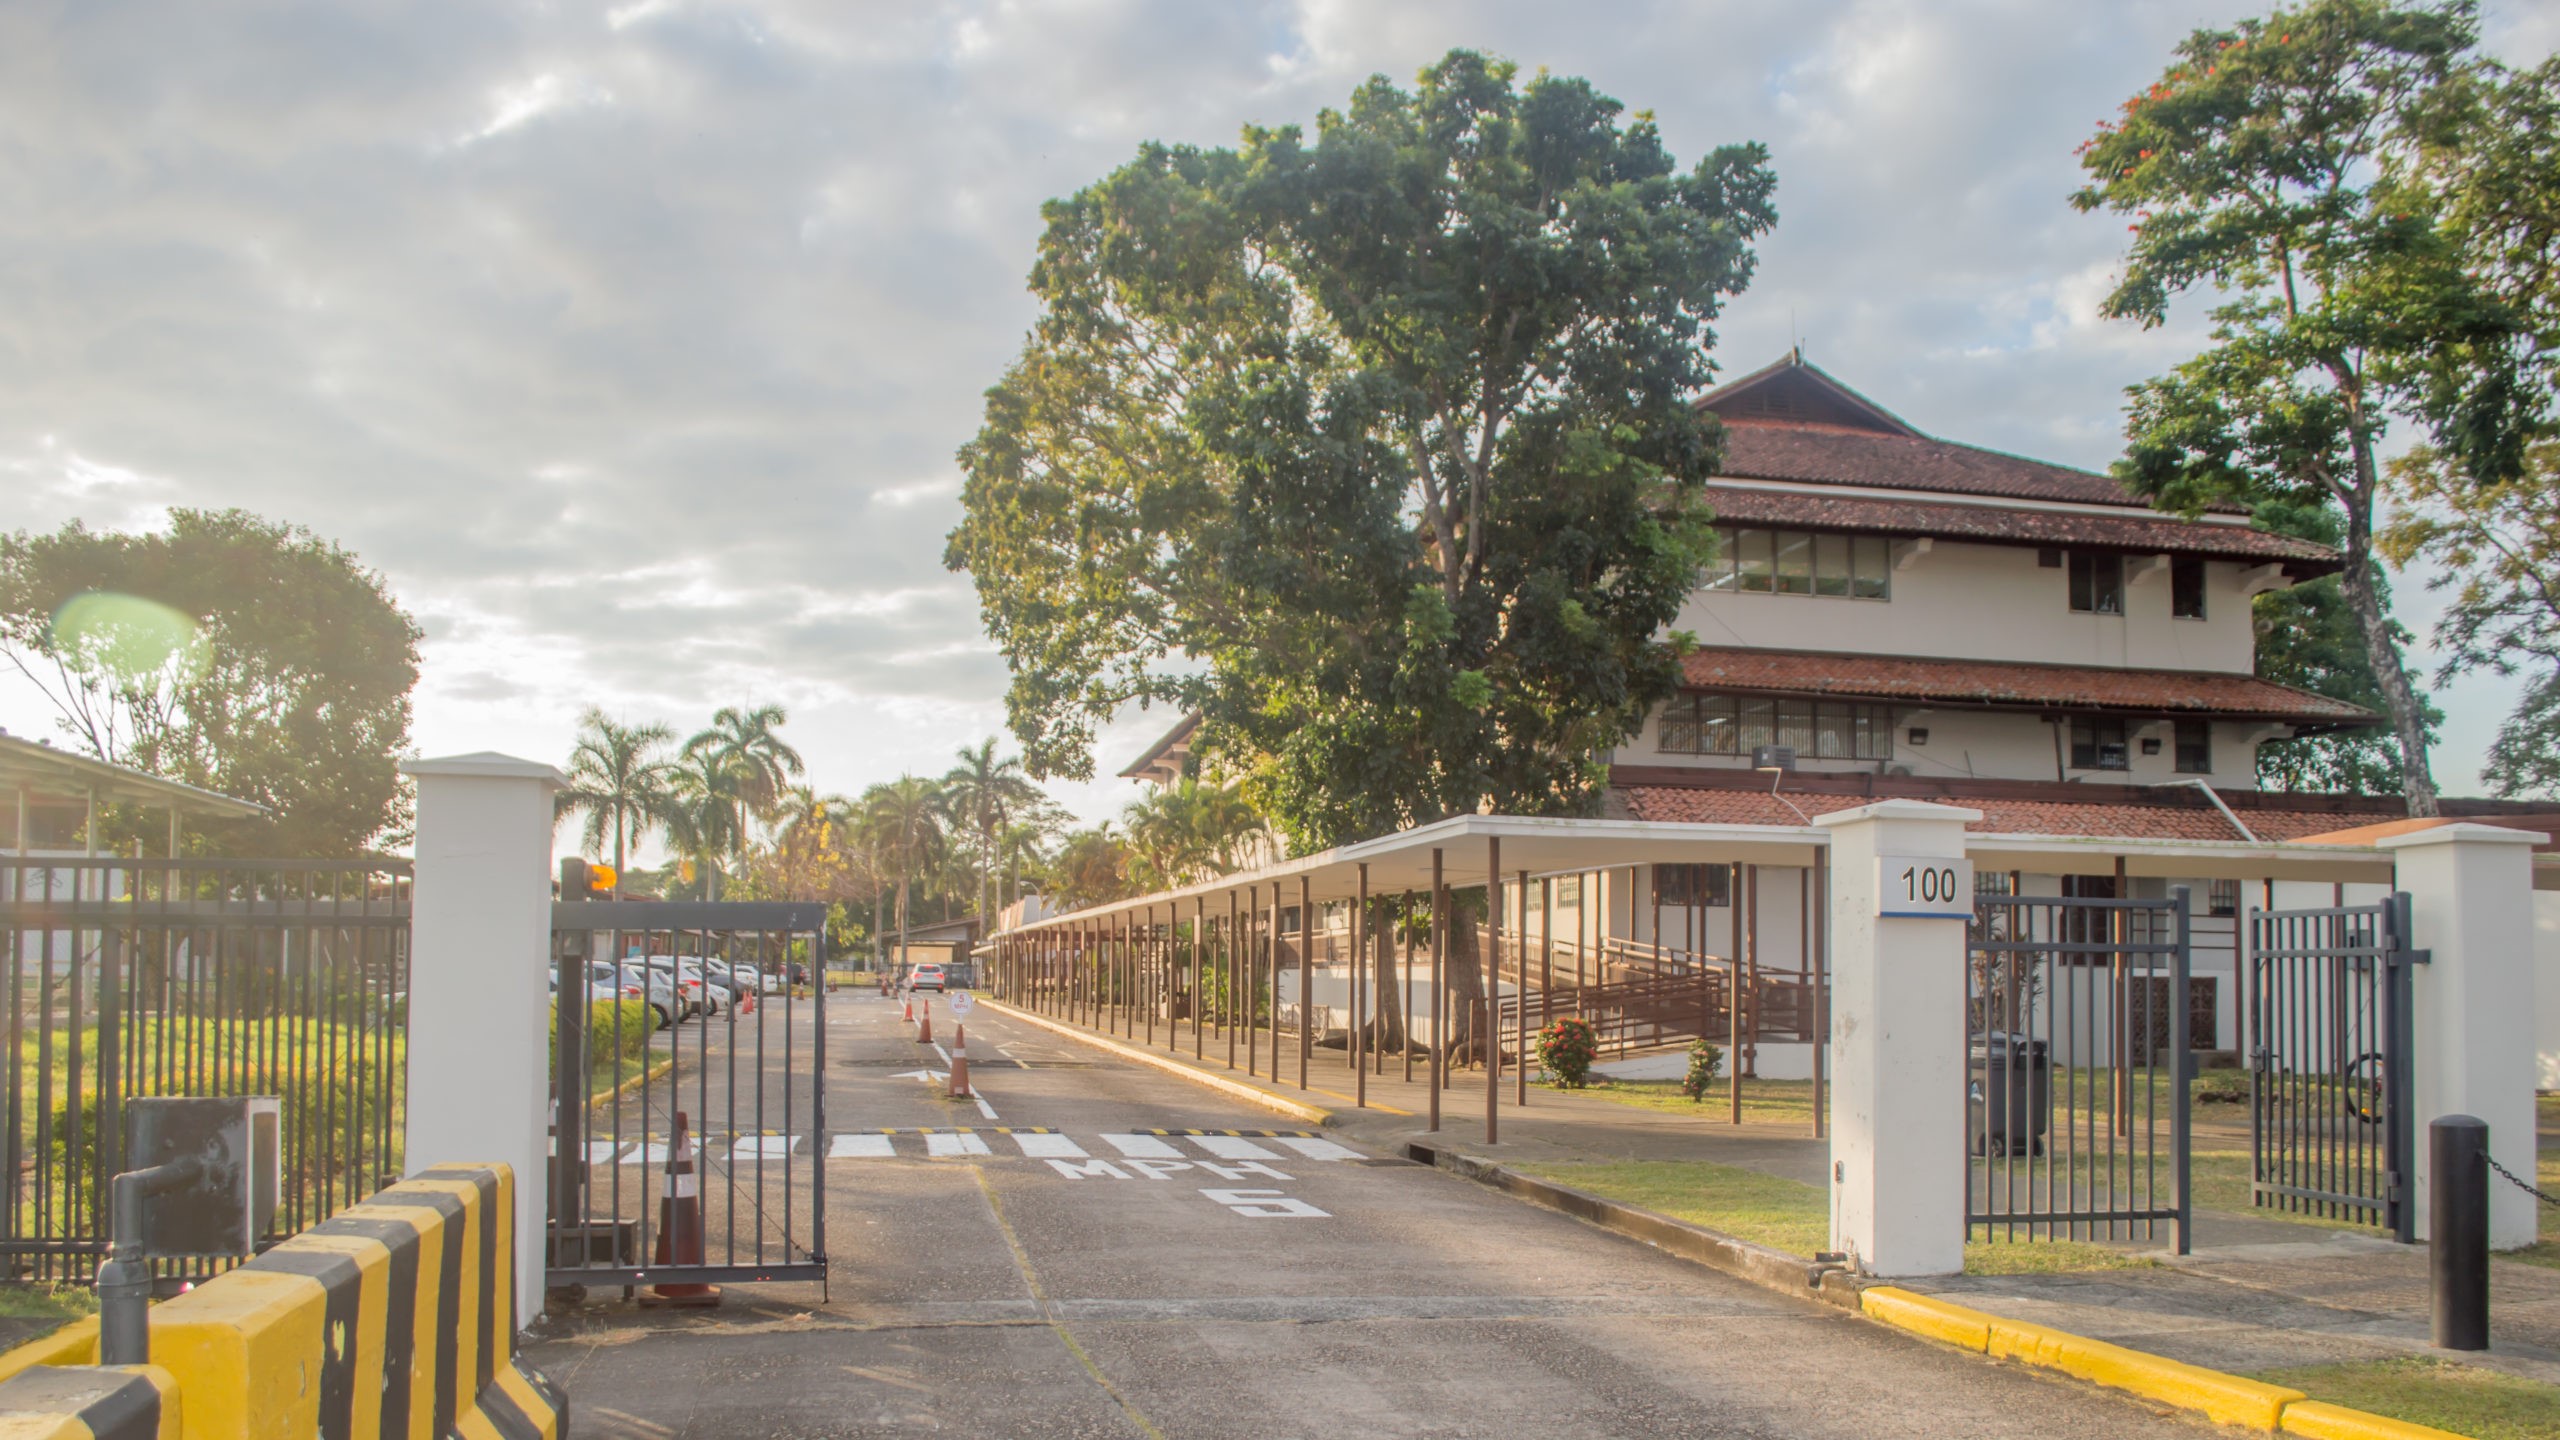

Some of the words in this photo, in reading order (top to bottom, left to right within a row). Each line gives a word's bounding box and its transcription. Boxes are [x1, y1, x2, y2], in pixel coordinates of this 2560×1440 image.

[1902, 866, 1956, 903] 100
[959, 993, 965, 1003] 5
[1043, 1158, 1297, 1181] MPH
[1197, 1188, 1334, 1218] 5
